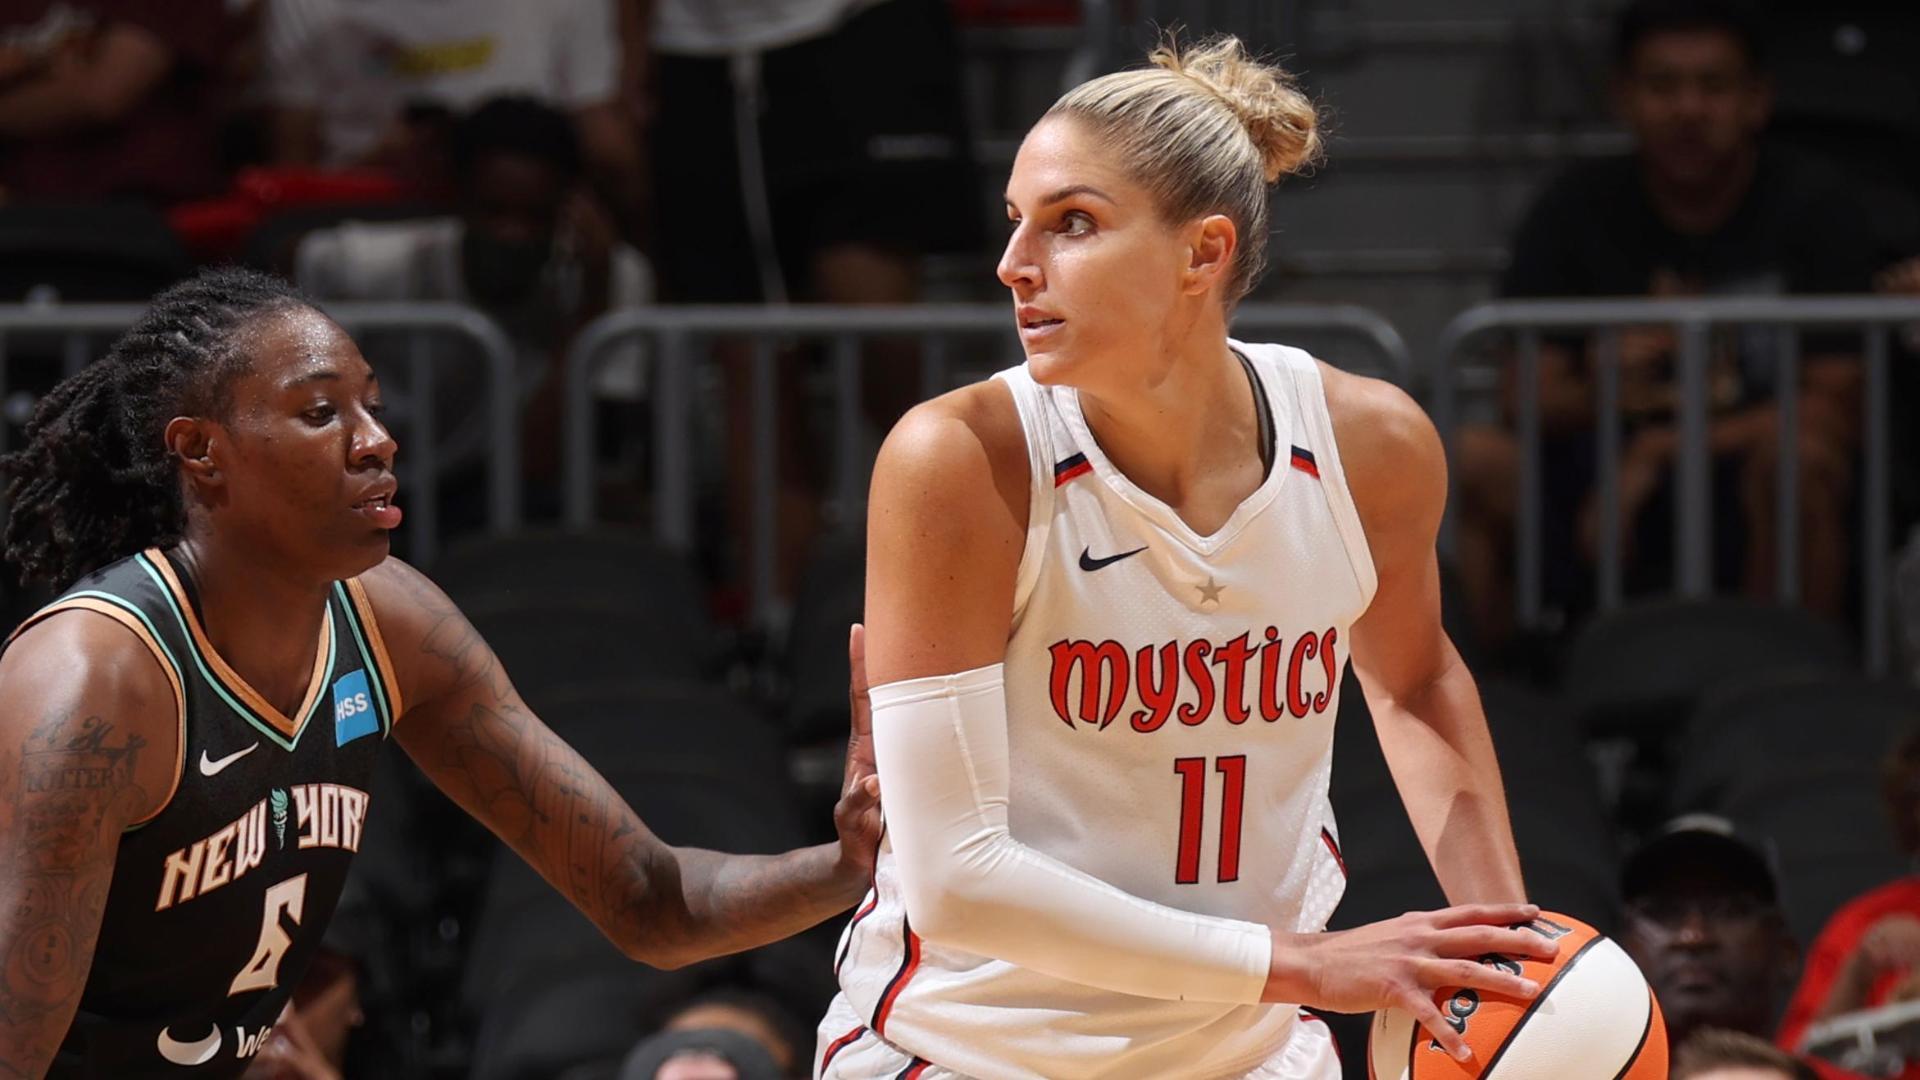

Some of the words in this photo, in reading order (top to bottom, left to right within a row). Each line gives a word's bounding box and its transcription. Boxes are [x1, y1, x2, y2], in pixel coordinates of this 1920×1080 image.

[336, 692, 368, 723] HSS
[154, 797, 267, 912] NEW
[1174, 755, 1247, 884] 11
[227, 872, 308, 998] 6
